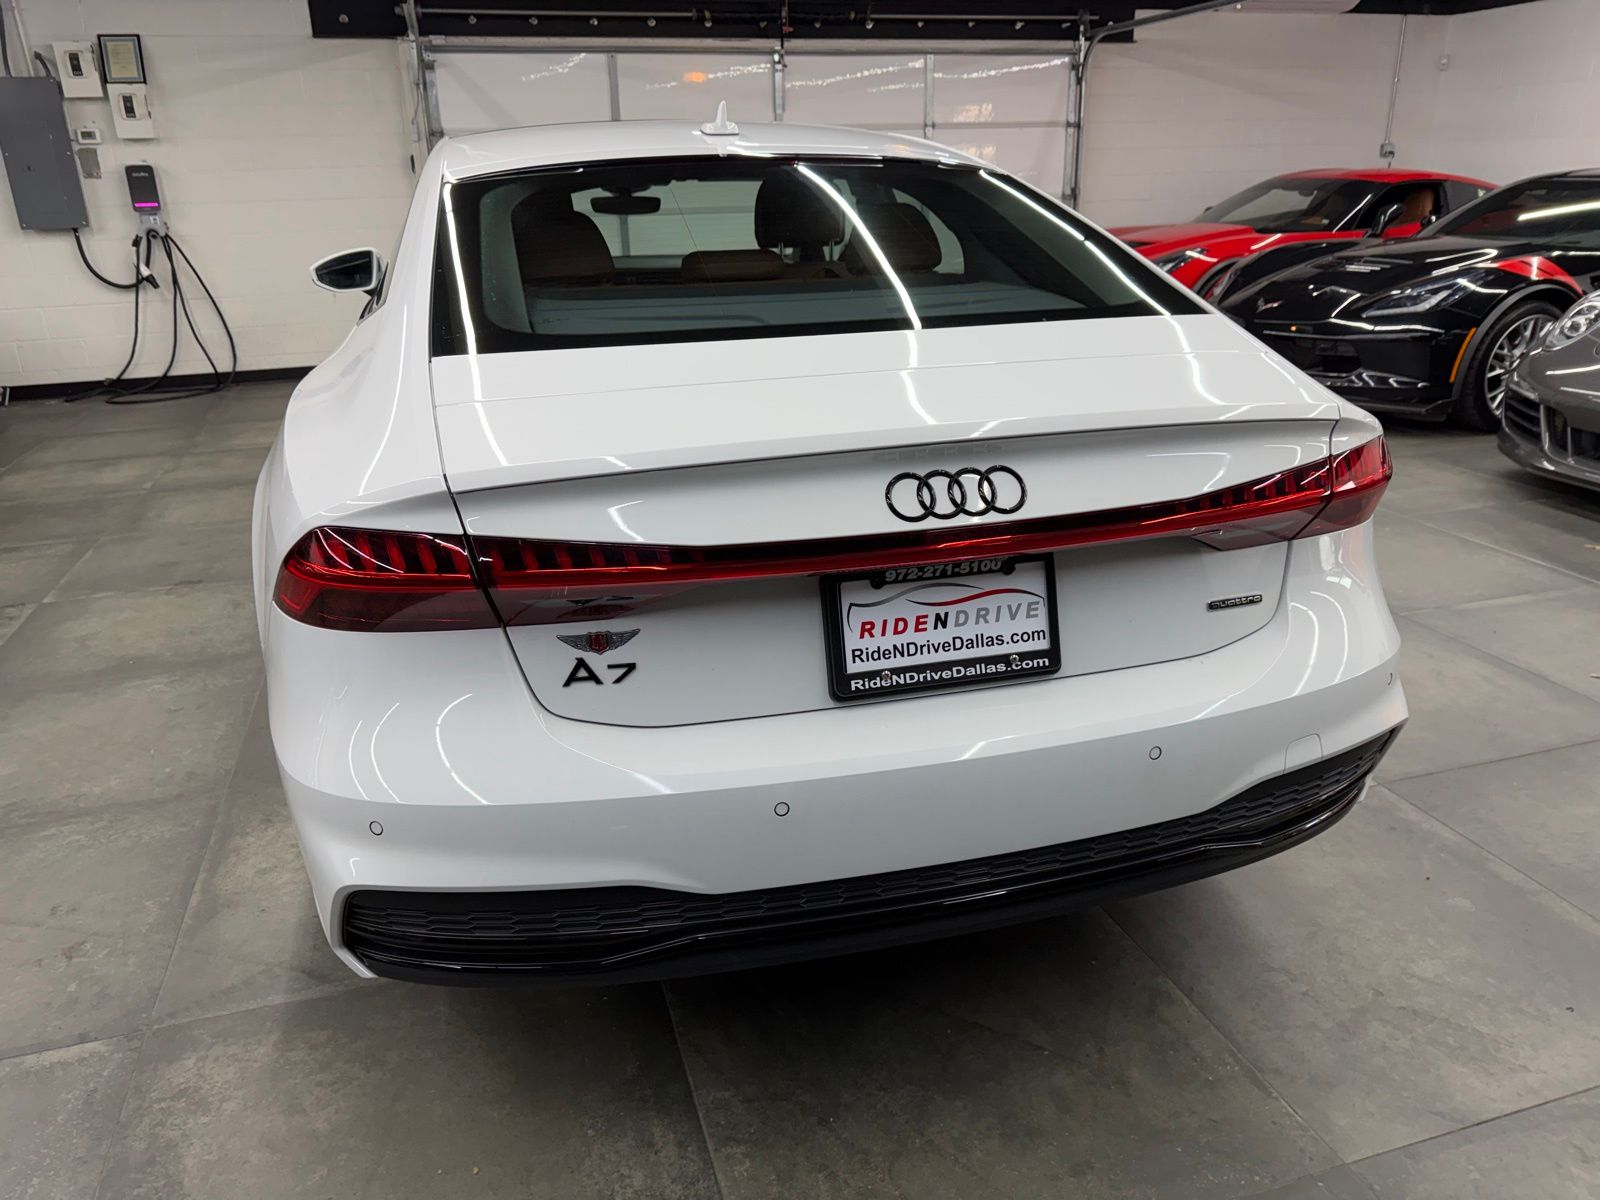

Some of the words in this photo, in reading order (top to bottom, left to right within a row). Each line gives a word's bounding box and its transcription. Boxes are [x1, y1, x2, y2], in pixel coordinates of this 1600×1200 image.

[885, 560, 1001, 582] 972-271-5100
[851, 629, 1046, 664] RideNDriveDallas.com
[563, 657, 637, 687] A7
[850, 657, 1049, 691] RideNDriveDallas.com
